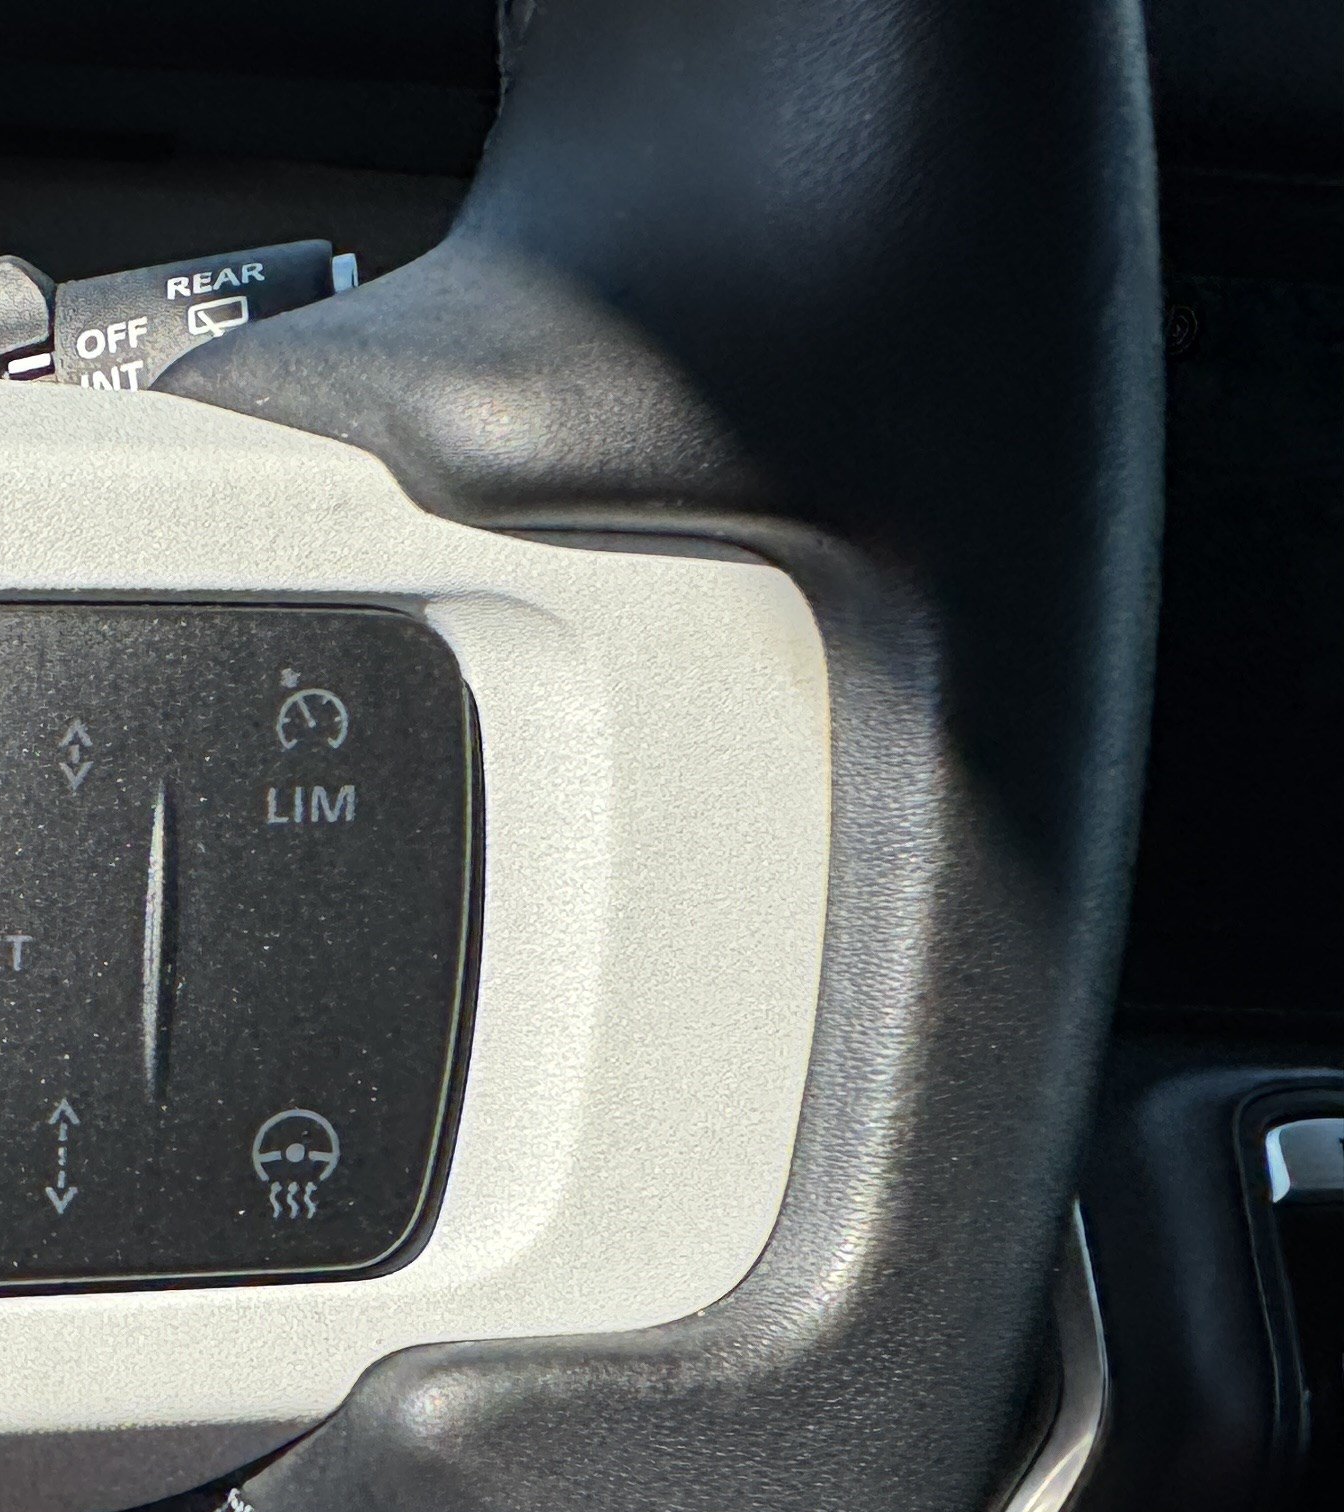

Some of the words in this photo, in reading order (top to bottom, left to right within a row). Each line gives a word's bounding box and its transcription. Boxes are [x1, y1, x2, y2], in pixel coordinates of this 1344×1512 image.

[166, 262, 266, 300] REAR
[76, 316, 149, 361] OFF
[79, 360, 145, 393] INT
[266, 784, 356, 825] LIM
